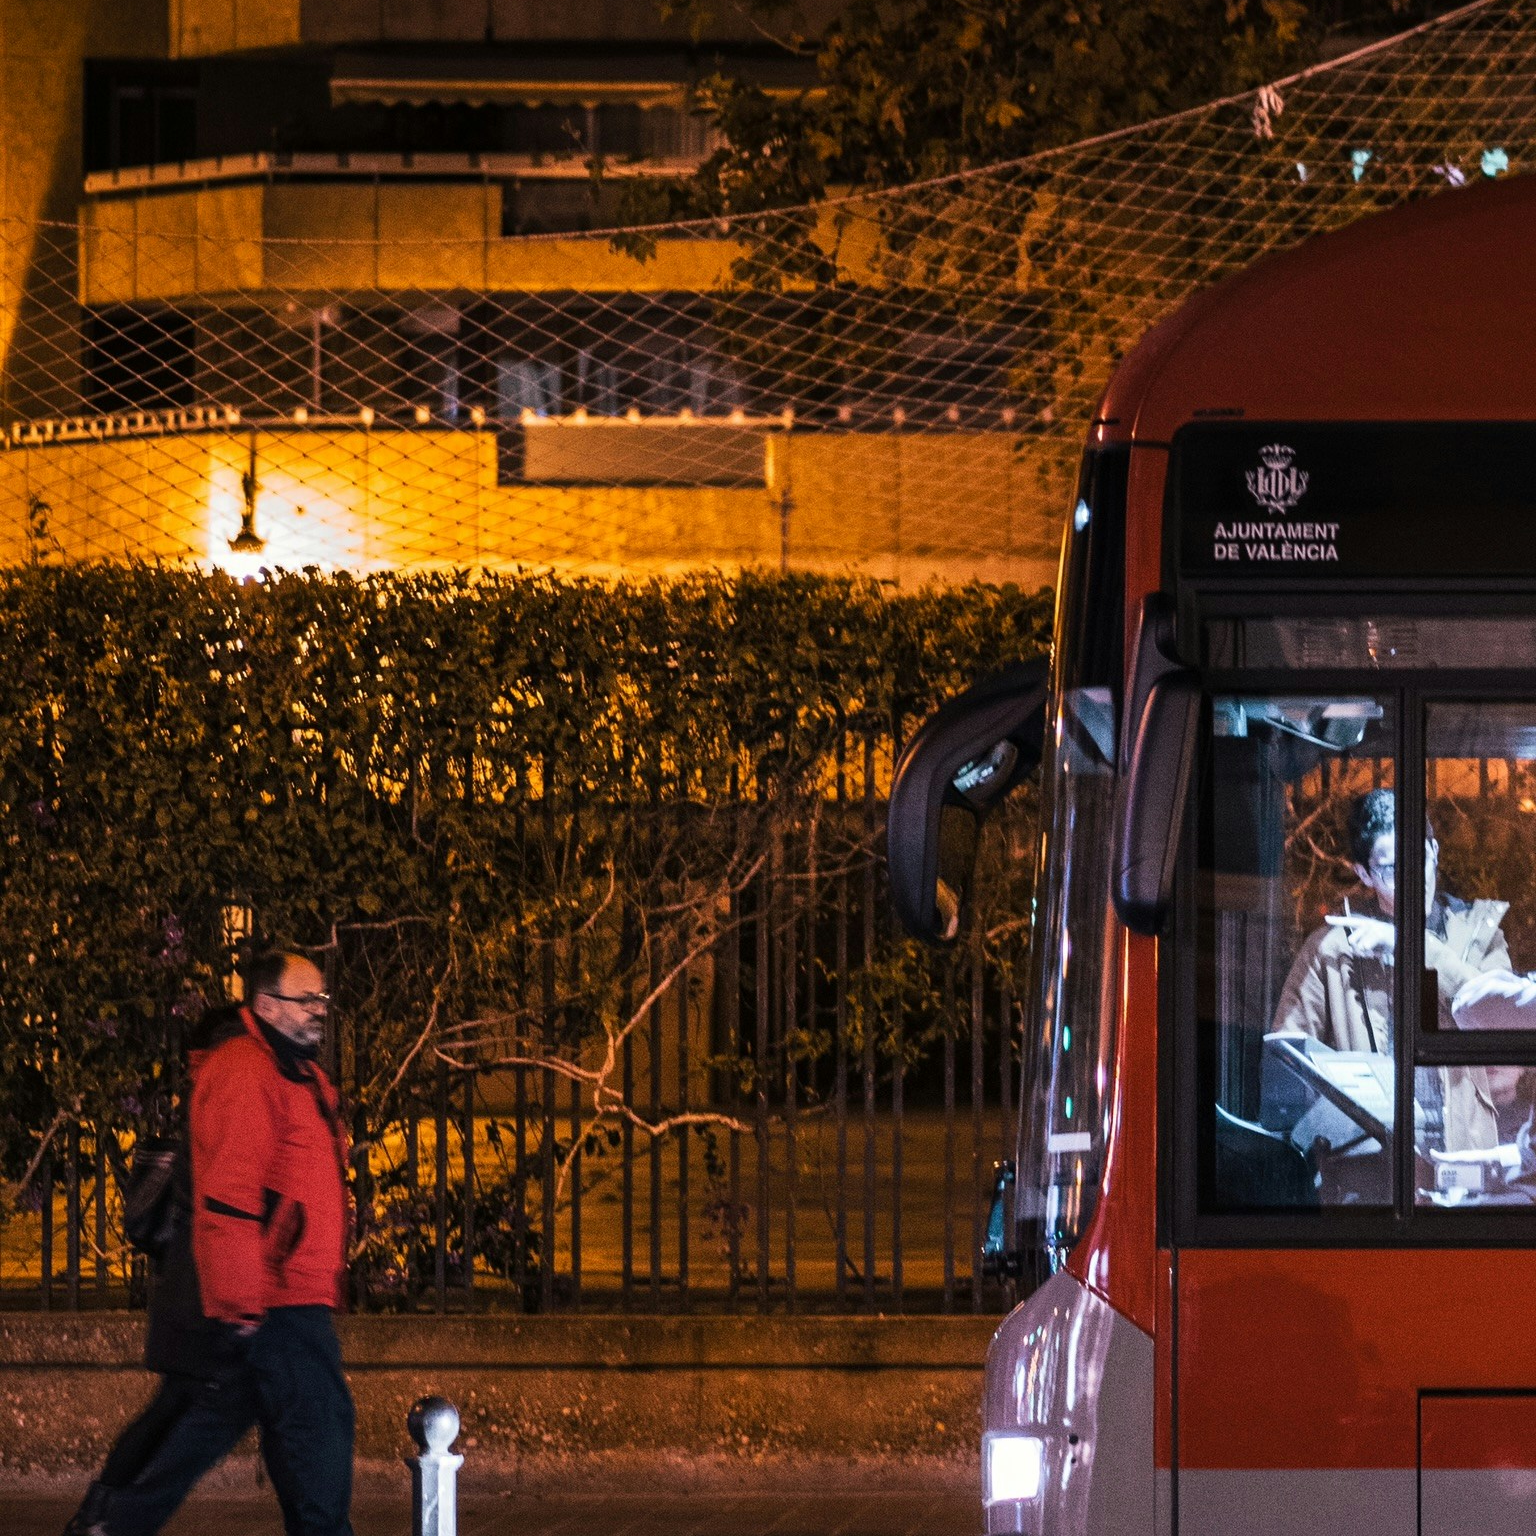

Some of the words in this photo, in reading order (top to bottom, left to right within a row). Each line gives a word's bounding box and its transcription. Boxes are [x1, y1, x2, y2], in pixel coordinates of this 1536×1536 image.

[1214, 522, 1340, 540] AJUNTAMENT
[1214, 543, 1240, 561] DE
[1245, 540, 1339, 561] VALÈNCIA
